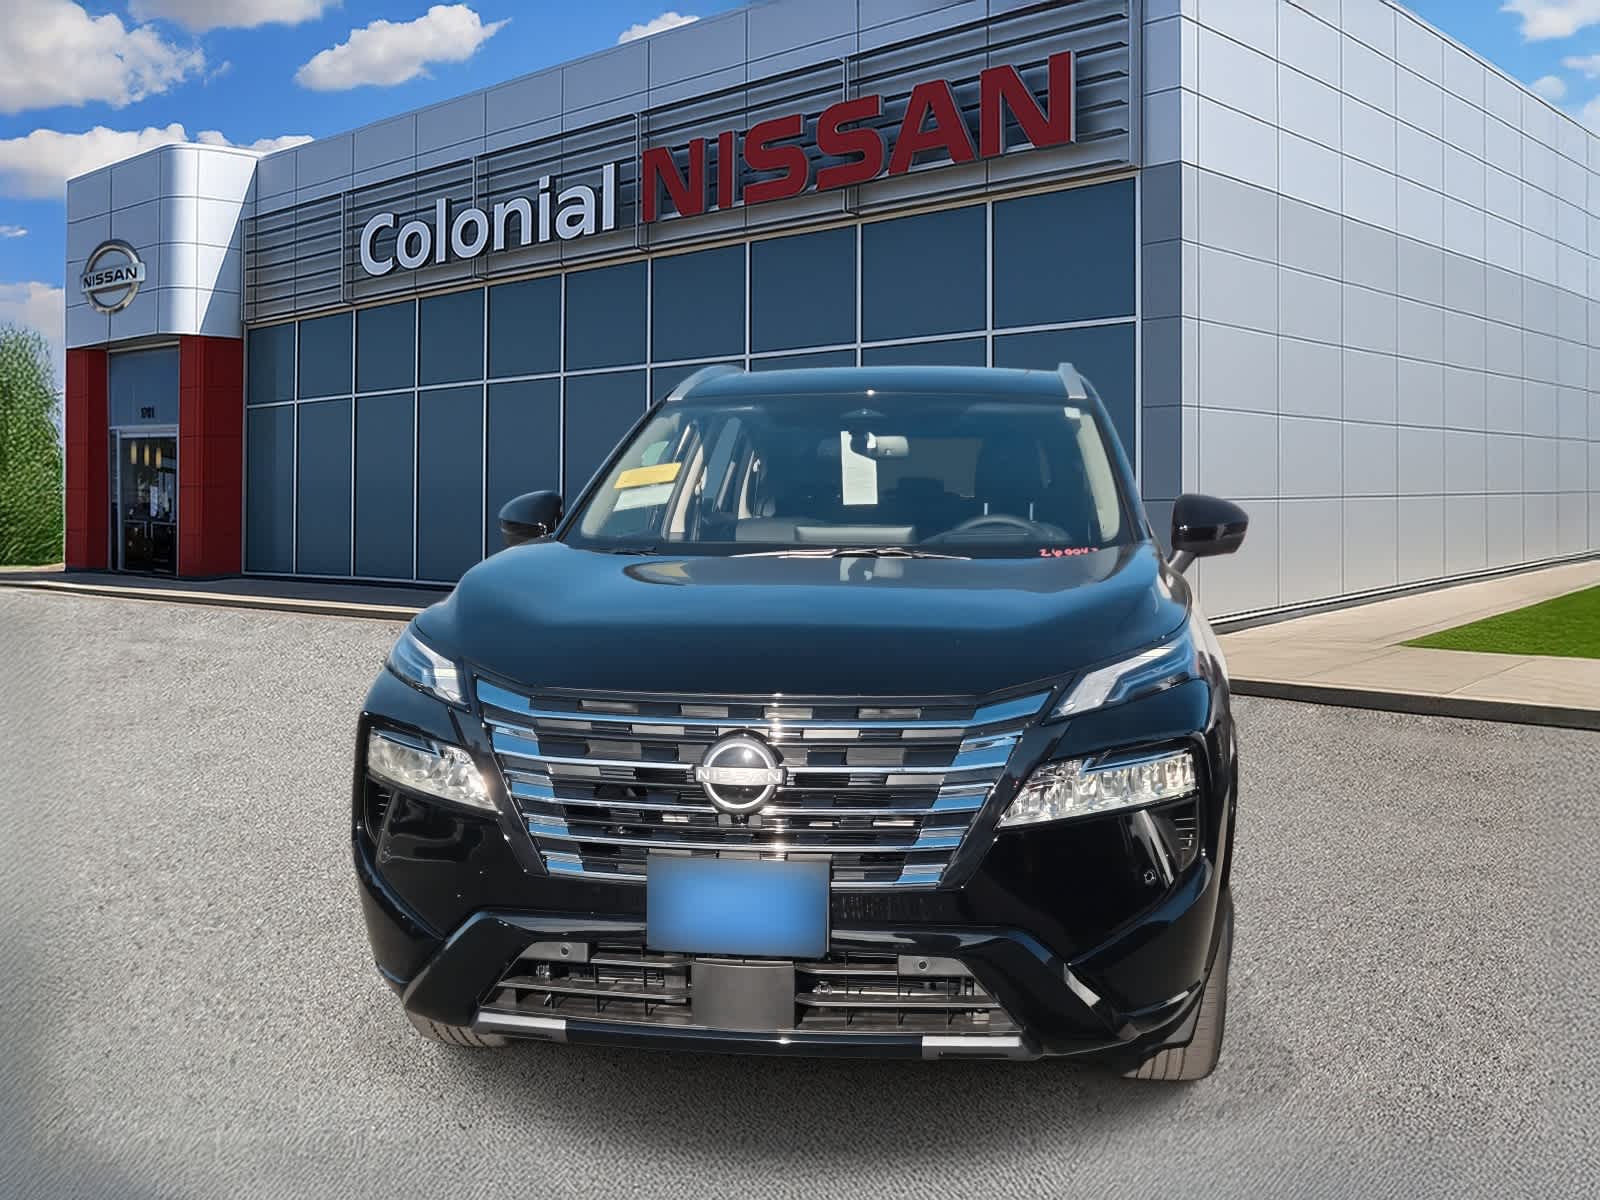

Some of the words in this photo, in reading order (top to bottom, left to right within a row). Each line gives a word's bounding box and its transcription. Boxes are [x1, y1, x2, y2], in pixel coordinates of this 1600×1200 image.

[359, 163, 617, 278] Colonial
[640, 50, 1077, 223] NISSAN
[83, 266, 138, 289] NISSAN
